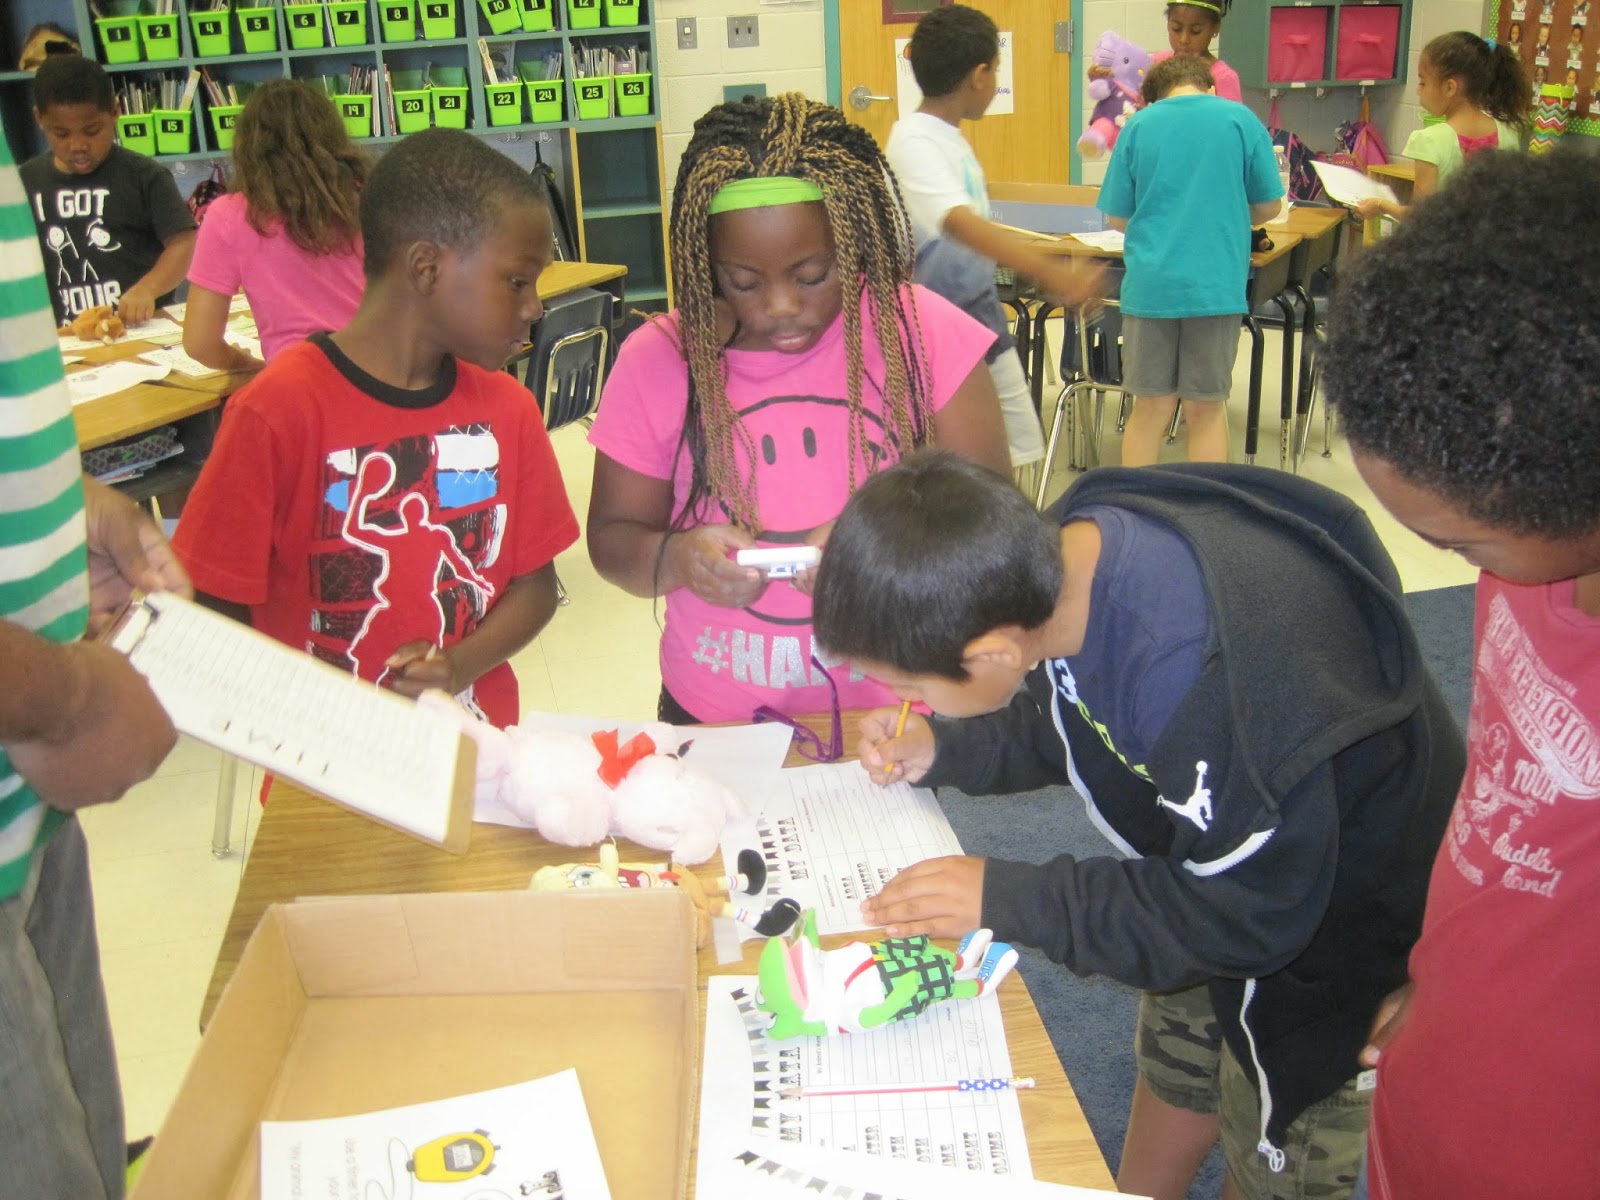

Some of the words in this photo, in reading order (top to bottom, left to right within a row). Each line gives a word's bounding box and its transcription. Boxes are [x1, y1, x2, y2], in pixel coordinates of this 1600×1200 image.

[493, 2, 506, 12] 10
[530, 0, 538, 9] 11
[394, 8, 402, 20] 8
[433, 5, 442, 17] 9
[300, 15, 309, 27] 6
[343, 12, 352, 24] 7
[205, 24, 215, 34] 4
[253, 19, 263, 31] 5
[155, 26, 164, 38] 2
[585, 87, 600, 98] 25
[627, 83, 641, 95] 26
[497, 93, 512, 104] 22
[538, 90, 553, 101] 24
[405, 101, 420, 112] 20
[444, 97, 455, 108] 21
[348, 104, 359, 116] 19
[167, 120, 178, 132] 15
[224, 116, 236, 128] 16
[129, 124, 141, 137] 14
[35, 192, 46, 222] I
[57, 188, 110, 219] GOT
[59, 280, 122, 316] YOUR
[1511, 758, 1560, 805] TOUR
[777, 816, 802, 852] DATA
[1492, 832, 1554, 874] Buddha
[788, 860, 809, 881] MY
[841, 876, 858, 900] AREA
[779, 1113, 802, 1143] MY
[988, 1131, 1009, 1174] OLUME
